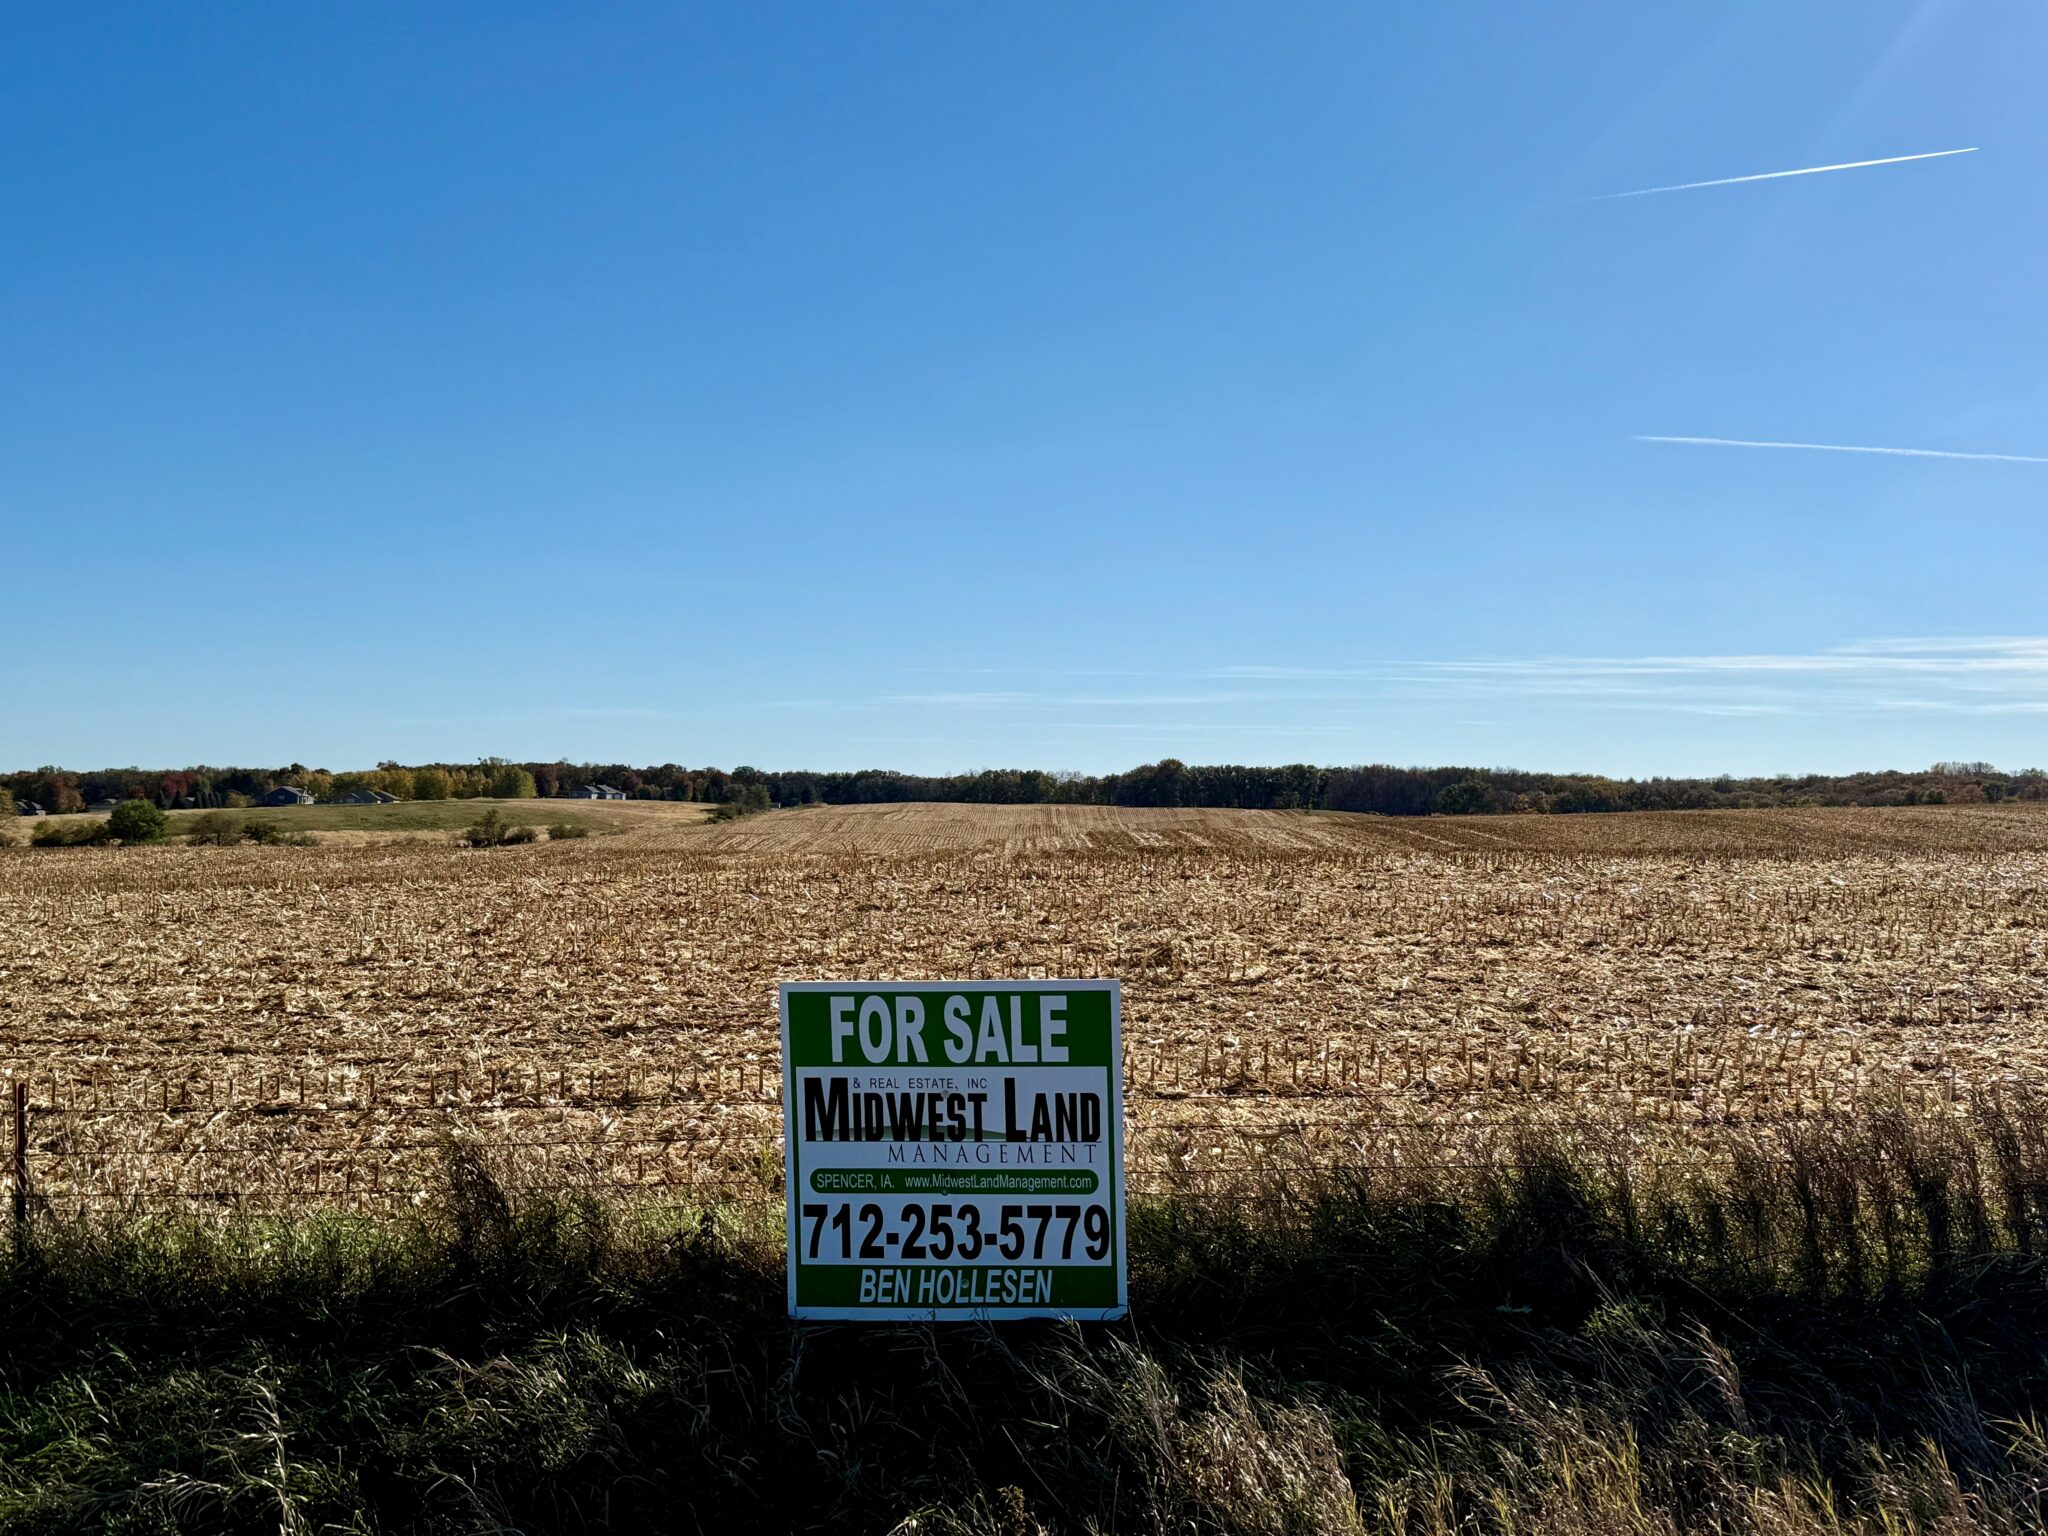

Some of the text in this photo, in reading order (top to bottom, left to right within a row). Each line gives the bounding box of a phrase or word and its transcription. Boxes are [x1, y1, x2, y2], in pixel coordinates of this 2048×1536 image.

[830, 994, 1069, 1064] FOR SALE
[853, 1077, 987, 1091] & REAL ESTATE, INC
[804, 1077, 1101, 1142] MIDWEST LAND
[888, 1144, 1097, 1164] MANAGEMENT
[816, 1173, 1092, 1192] SPENCER, IA. www.MidwestLandManagement.com
[803, 1203, 1110, 1260] 712-253-5779
[859, 1269, 1053, 1304] BEN HOLLESEN
